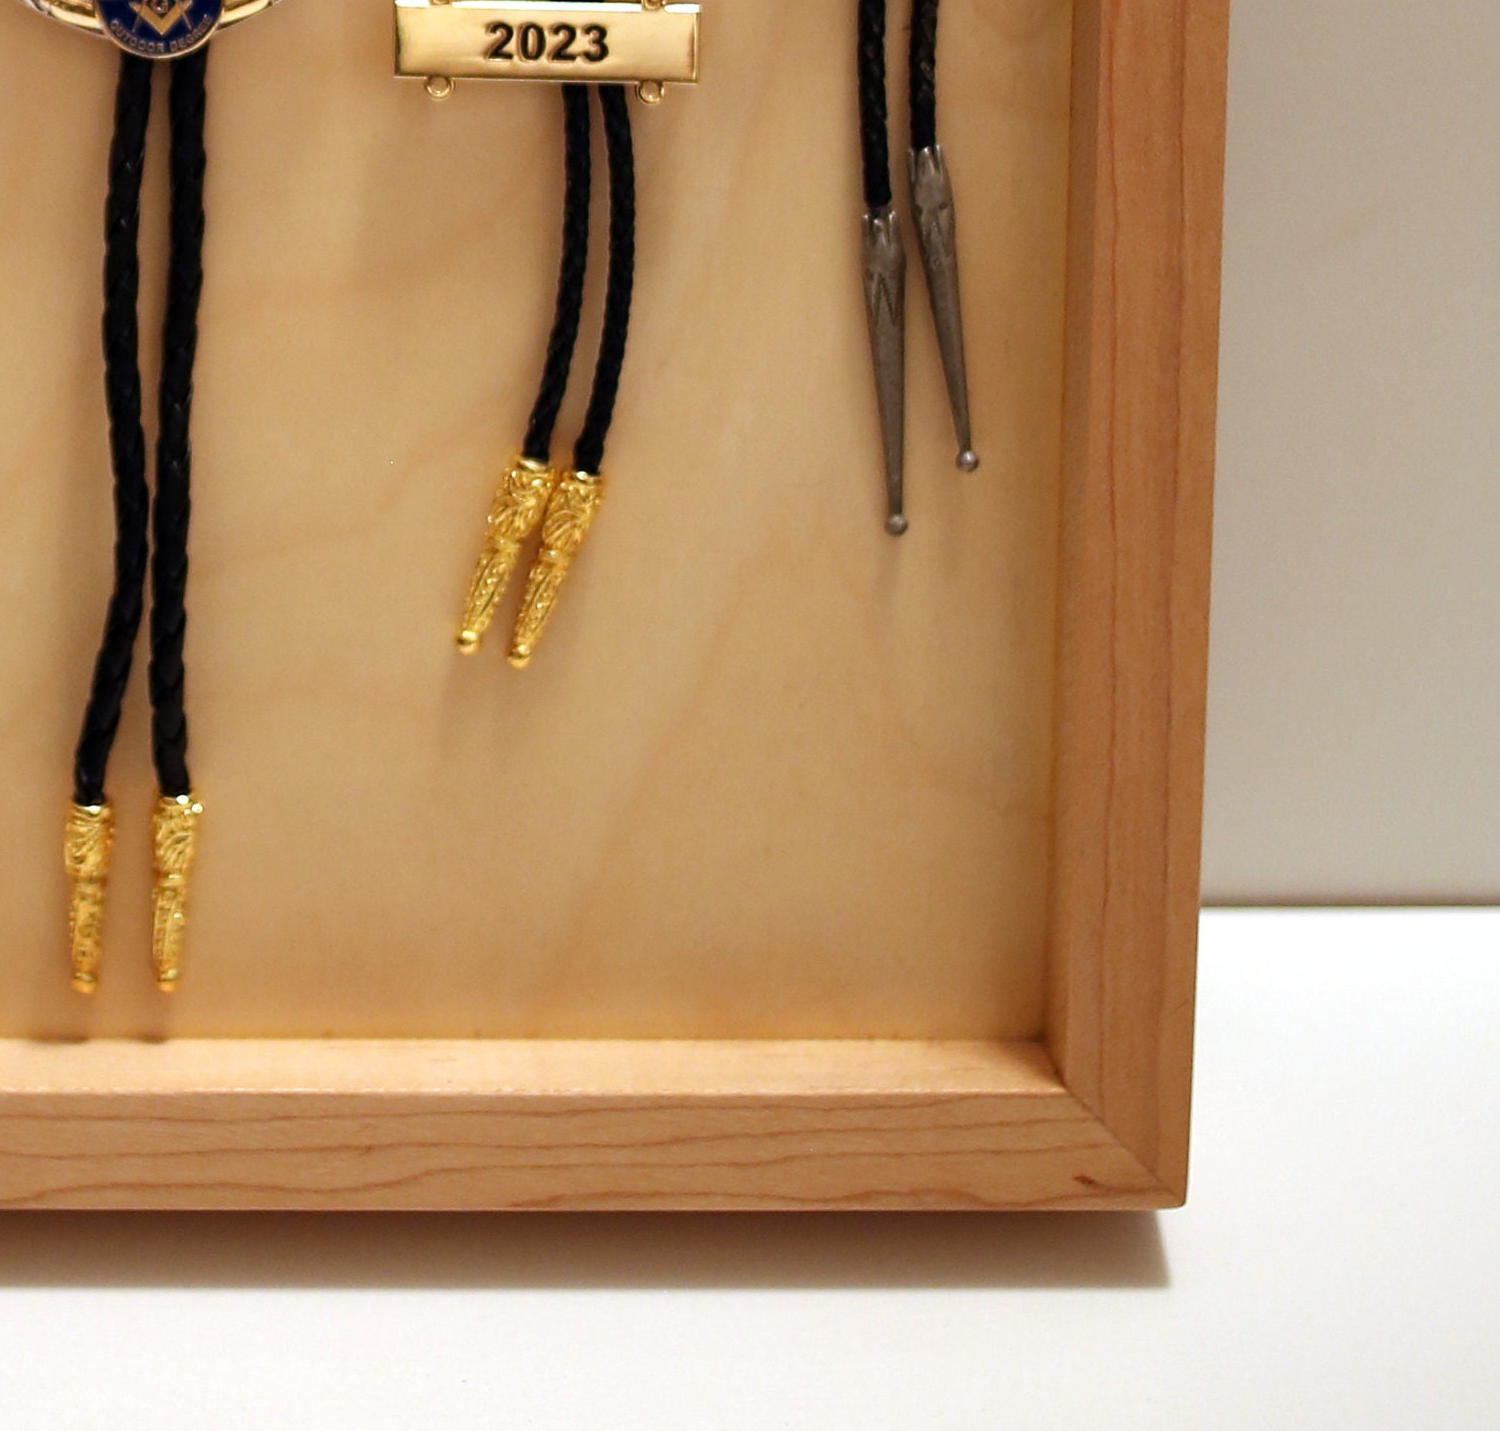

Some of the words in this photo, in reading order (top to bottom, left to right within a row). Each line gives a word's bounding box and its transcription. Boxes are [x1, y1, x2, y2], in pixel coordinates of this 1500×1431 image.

[110, 19, 165, 52] OUTDOOR
[168, 13, 213, 52] DEGREE
[484, 21, 610, 64] 2023
